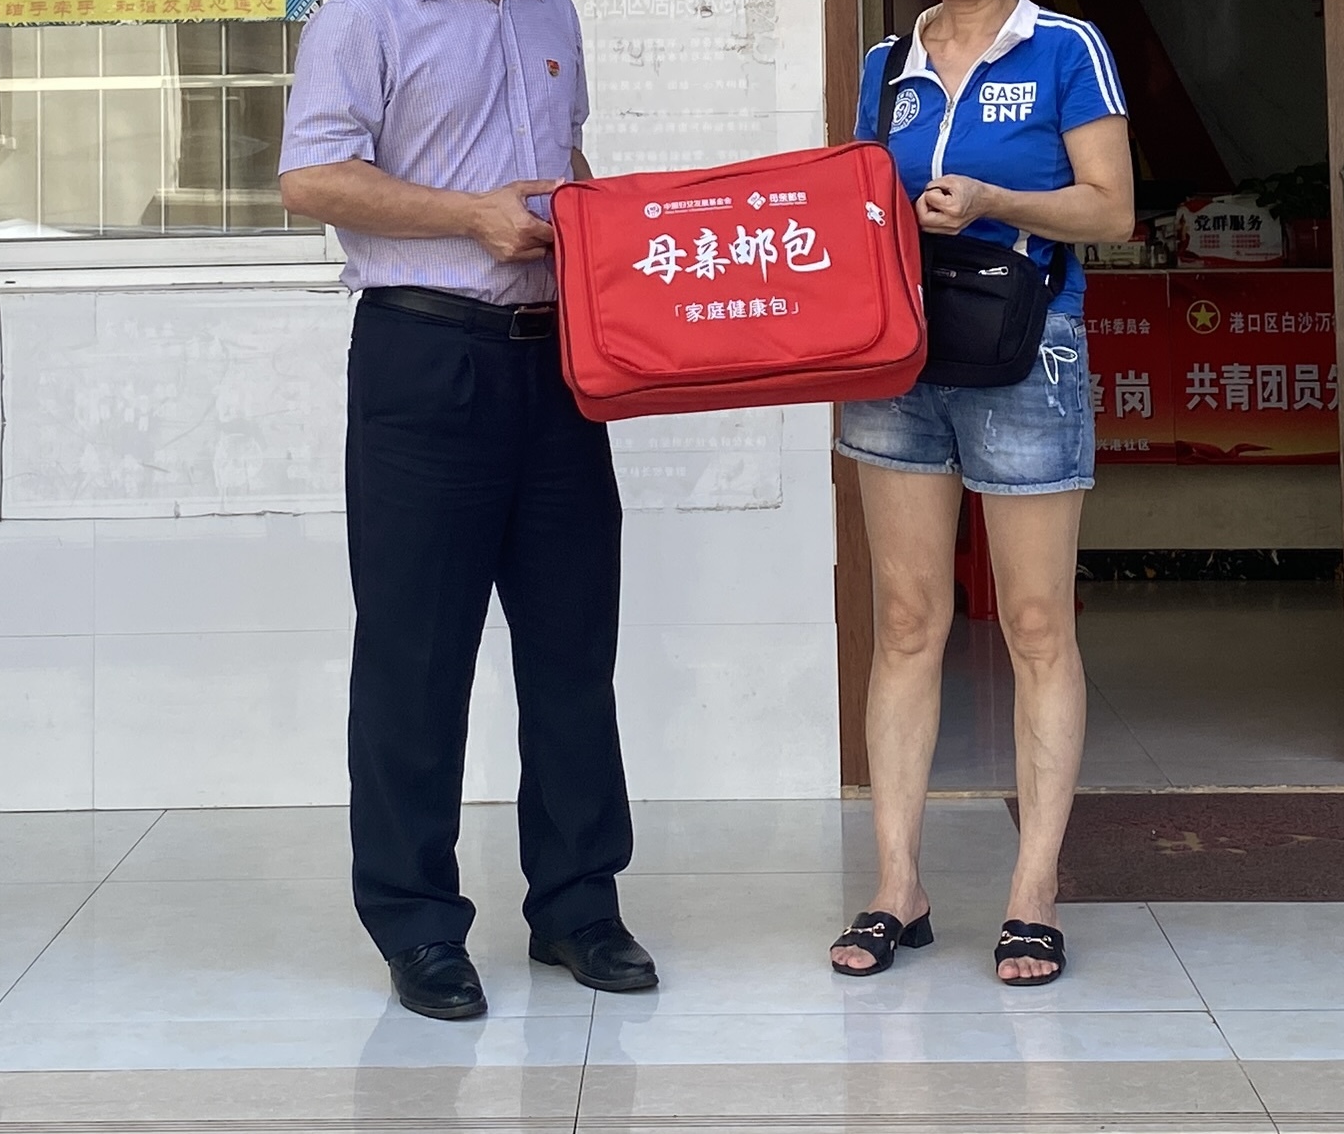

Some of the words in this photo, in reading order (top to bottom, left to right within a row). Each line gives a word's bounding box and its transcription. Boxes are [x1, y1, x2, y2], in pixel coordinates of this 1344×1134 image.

[981, 83, 1035, 103] GASH
[982, 103, 1033, 123] BNF
[769, 191, 807, 203] 母亲邮包
[1194, 214, 1263, 232] 党群服务
[632, 218, 832, 284] 母亲邮包
